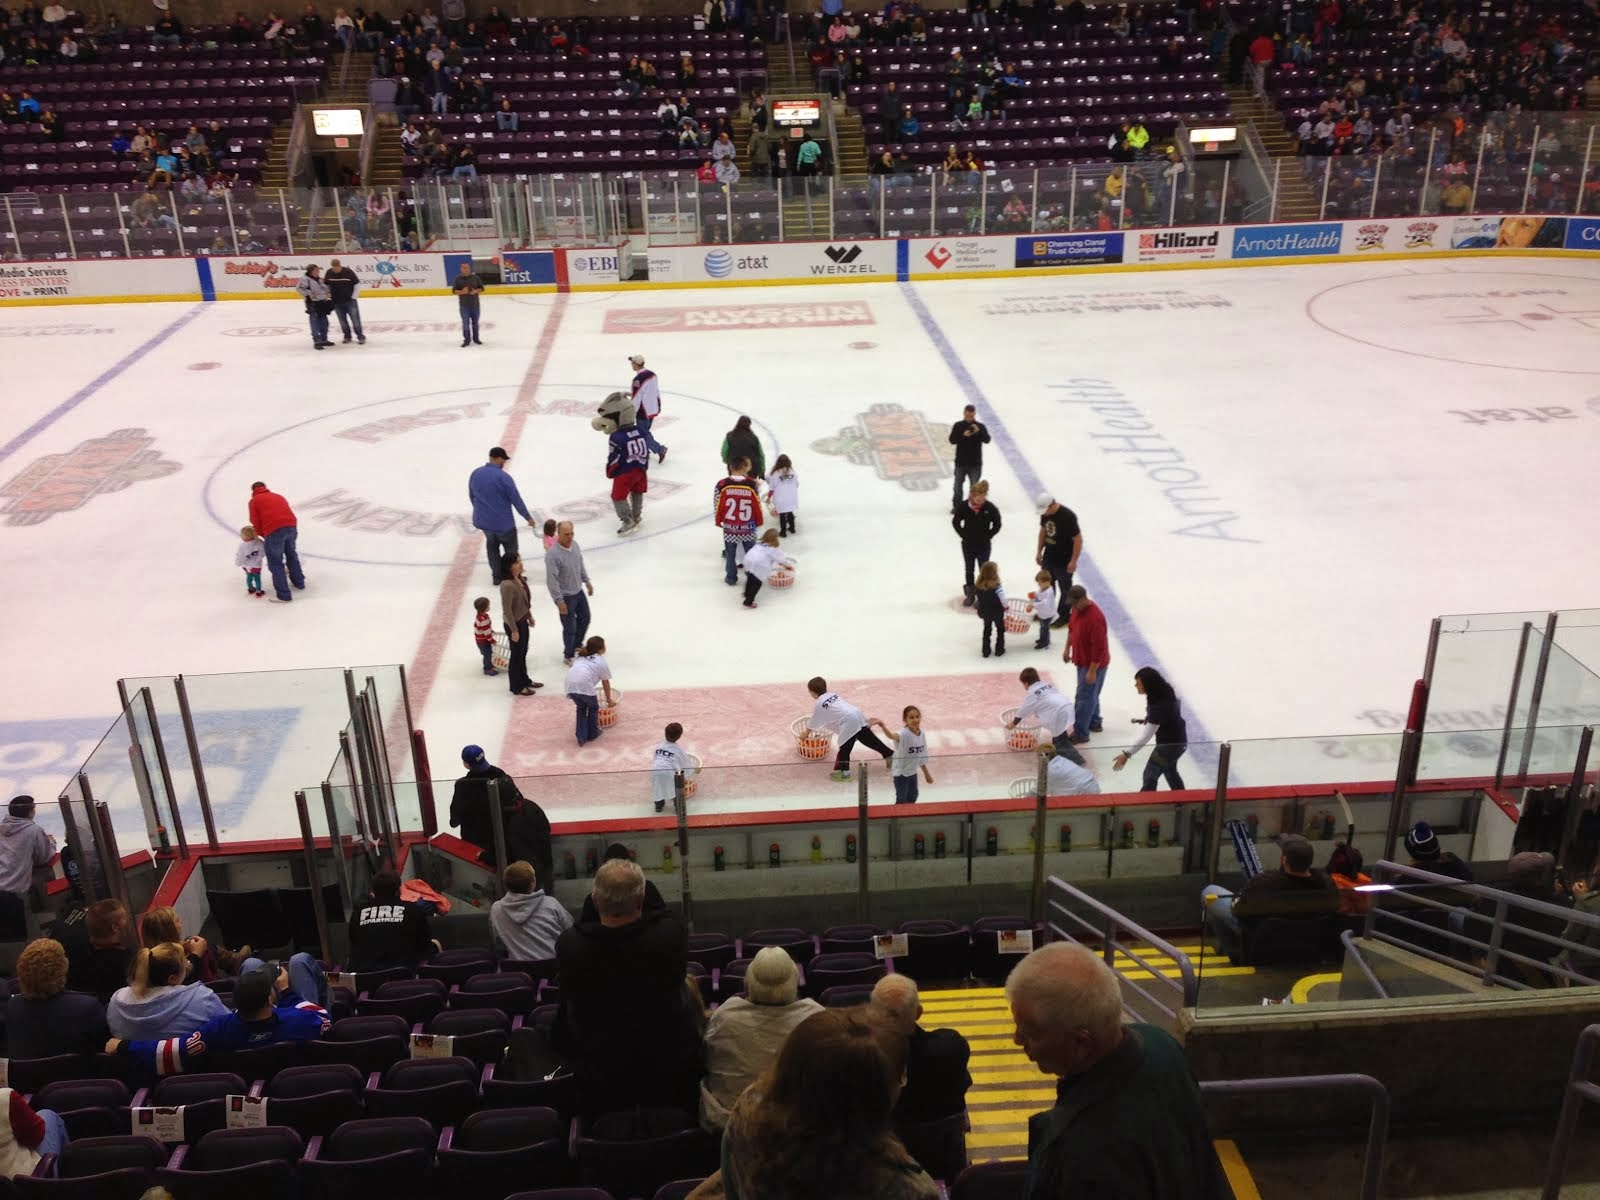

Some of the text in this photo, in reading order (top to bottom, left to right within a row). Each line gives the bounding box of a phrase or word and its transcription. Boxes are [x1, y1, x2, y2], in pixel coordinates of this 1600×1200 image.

[1047, 240, 1083, 248] Chemung
[1068, 246, 1106, 254] Company
[737, 254, 769, 269] at&t
[28, 265, 68, 277] Services
[810, 264, 877, 274] WENZEL
[504, 269, 532, 282] First
[20, 277, 69, 287] PRINTERS
[33, 286, 68, 296] PRINT!
[725, 497, 752, 522] 25
[360, 904, 406, 922] FIRE
[359, 917, 404, 926] DEPARTMENT
